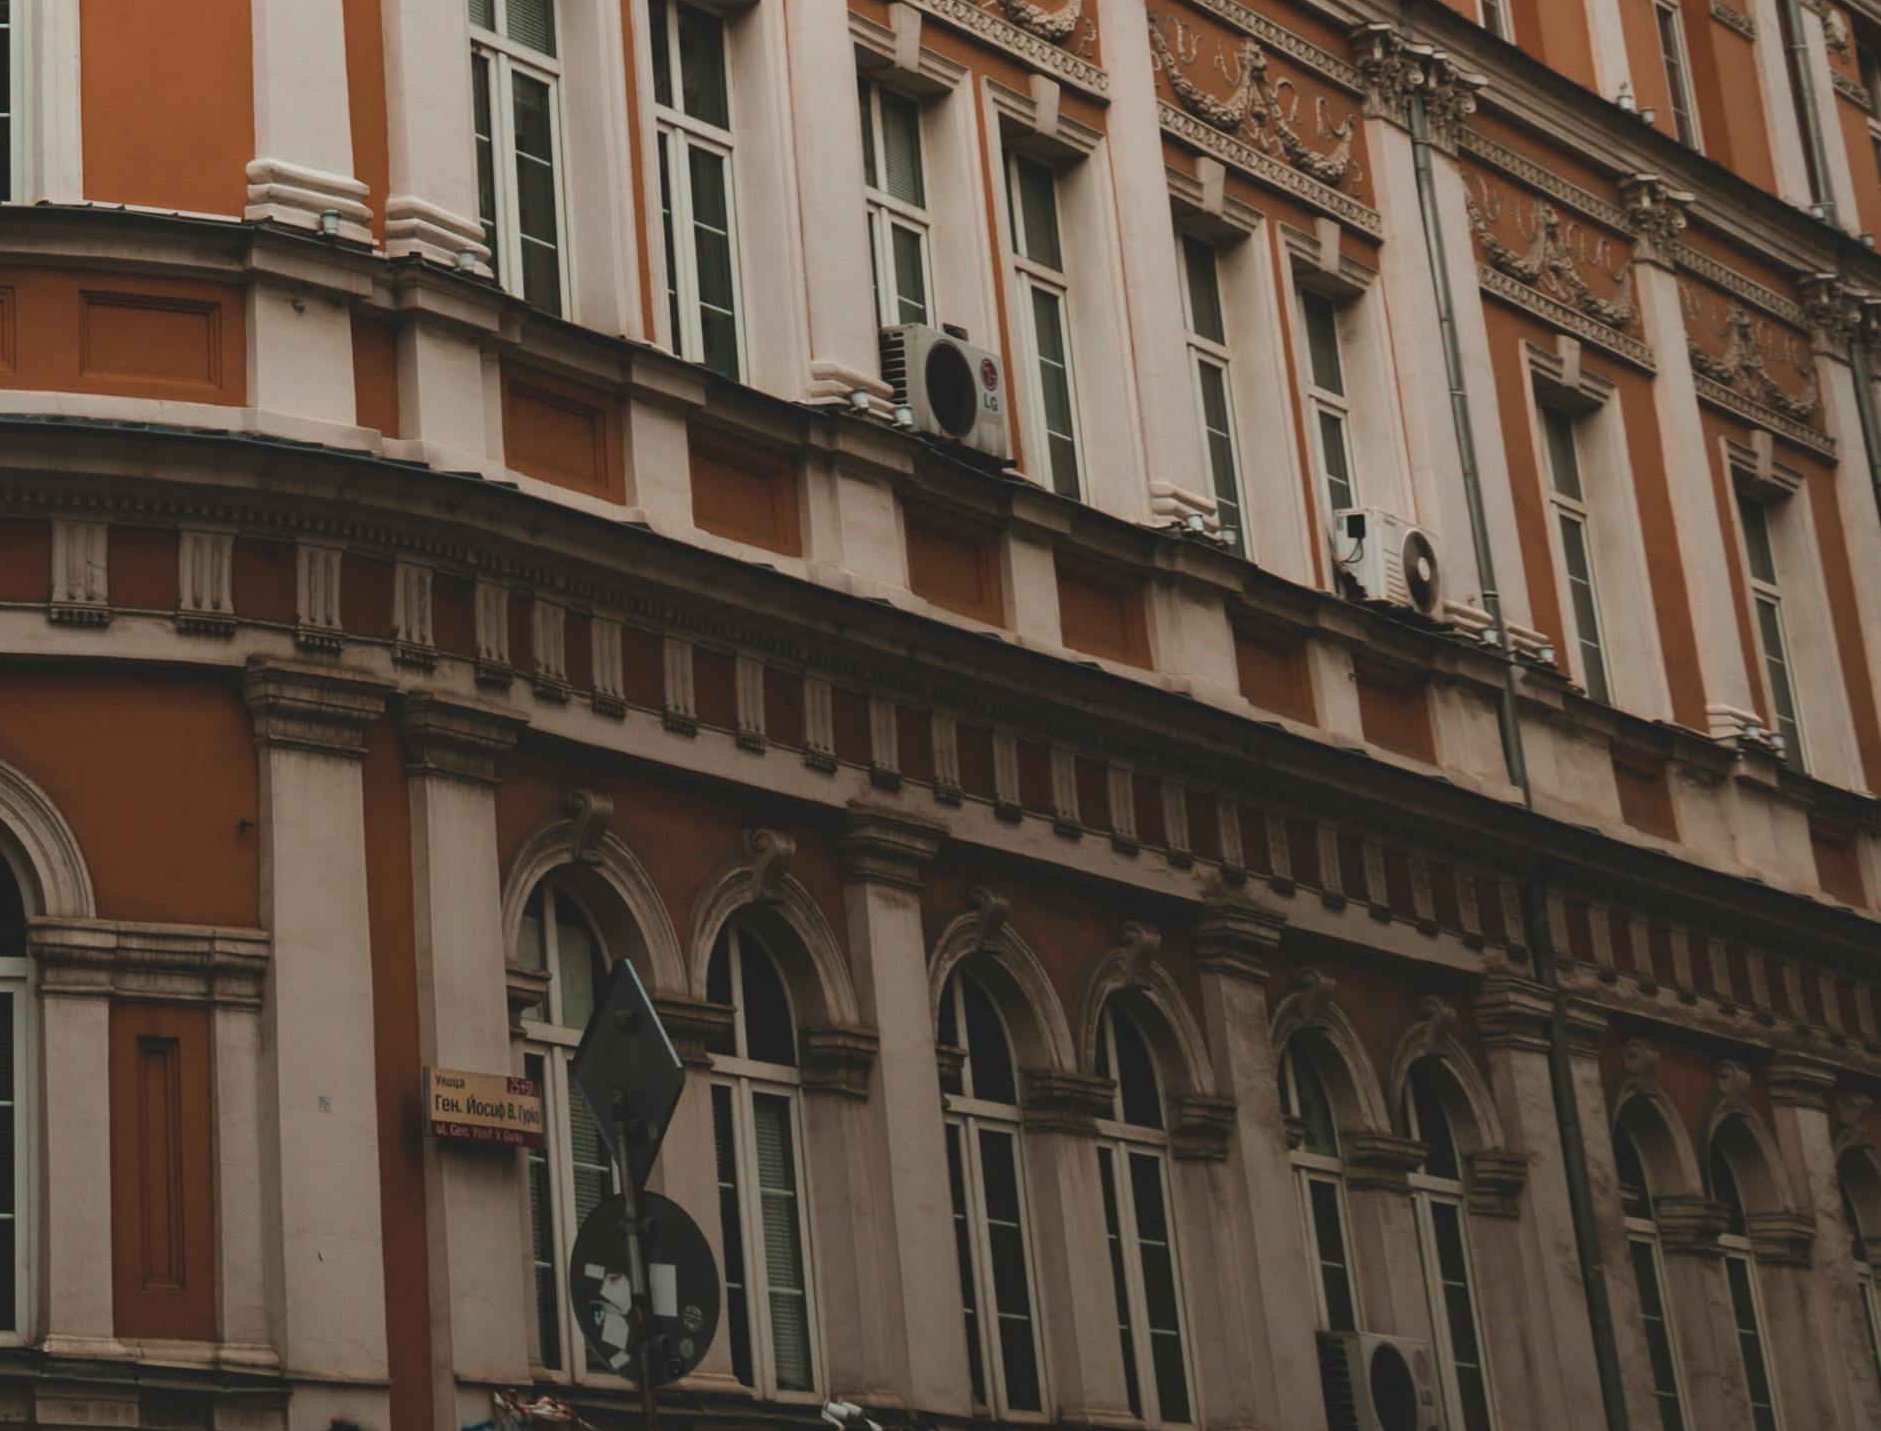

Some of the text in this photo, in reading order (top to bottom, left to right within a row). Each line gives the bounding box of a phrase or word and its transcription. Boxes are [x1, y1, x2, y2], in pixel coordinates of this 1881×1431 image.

[983, 393, 998, 411] LG
[435, 1074, 465, 1088] Улица
[435, 1094, 462, 1113] Ген.
[467, 1093, 505, 1122] Йосиф
[508, 1103, 516, 1119] В.
[450, 1124, 470, 1137] Gen.
